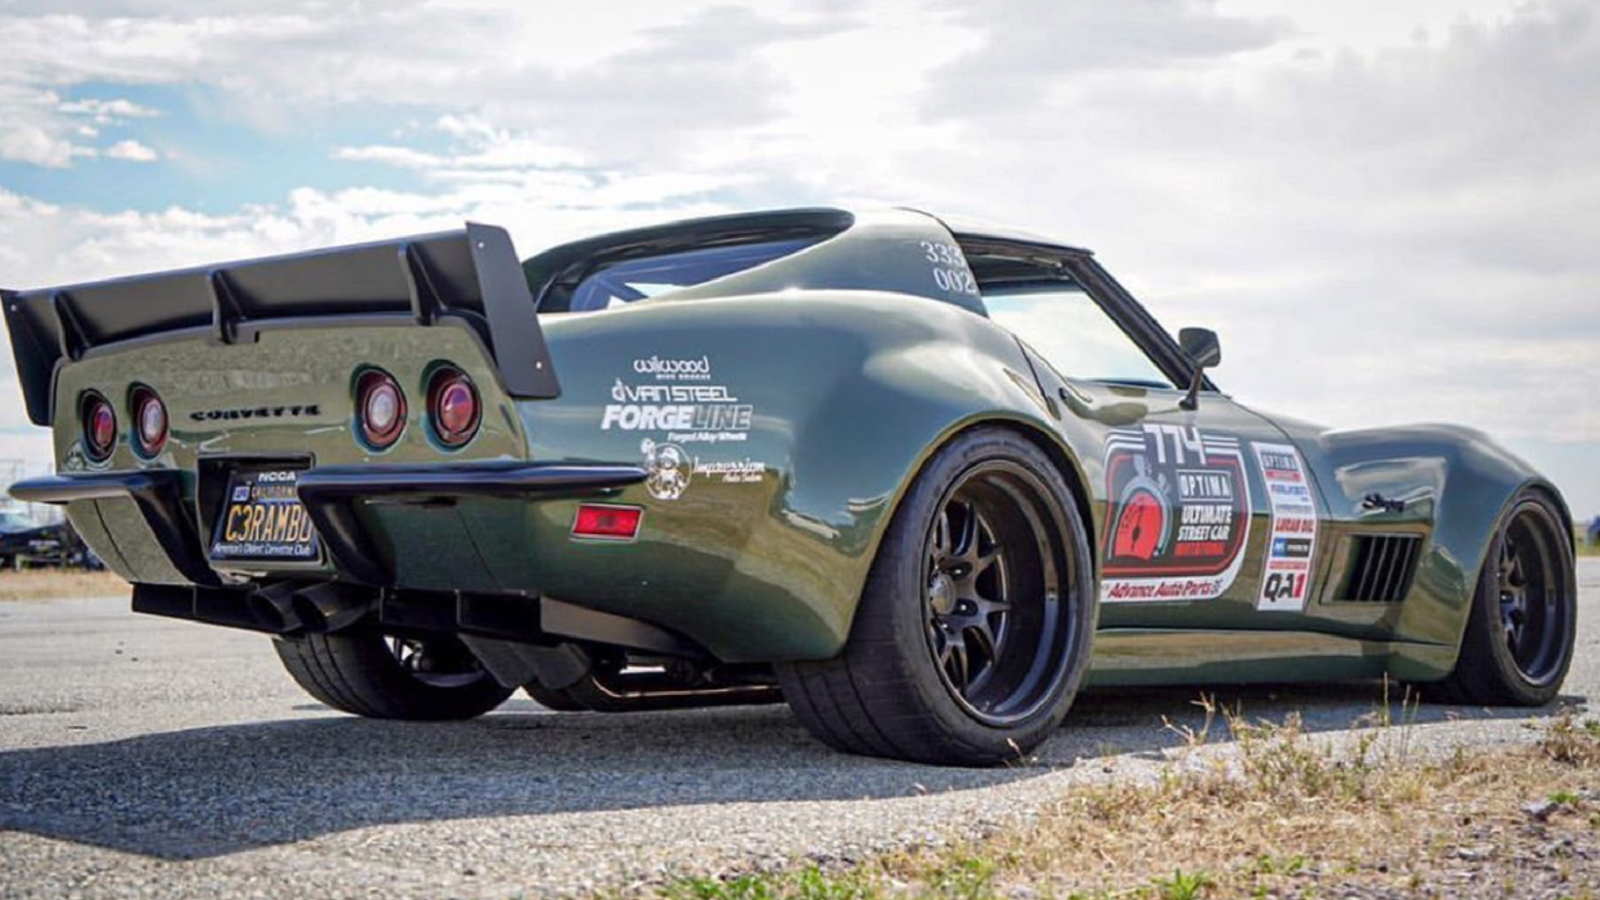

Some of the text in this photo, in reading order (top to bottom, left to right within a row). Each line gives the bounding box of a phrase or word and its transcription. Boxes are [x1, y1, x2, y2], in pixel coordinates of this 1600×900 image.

[933, 267, 977, 295] 002
[633, 355, 710, 374] wilwood
[188, 405, 321, 421] CORVETTE
[601, 404, 753, 431] FORGELINE
[1142, 423, 1207, 465] 774
[258, 471, 296, 482] NCCA
[1179, 475, 1230, 497] OPTIMA
[225, 503, 313, 543] C3RAMBO
[1181, 505, 1232, 525] ULTIMATE
[1177, 525, 1231, 541] STREET CAR
[1108, 583, 1156, 599] Advance
[1155, 582, 1184, 597] Auto
[1183, 581, 1212, 597] Parts
[1263, 572, 1306, 602] QA1
